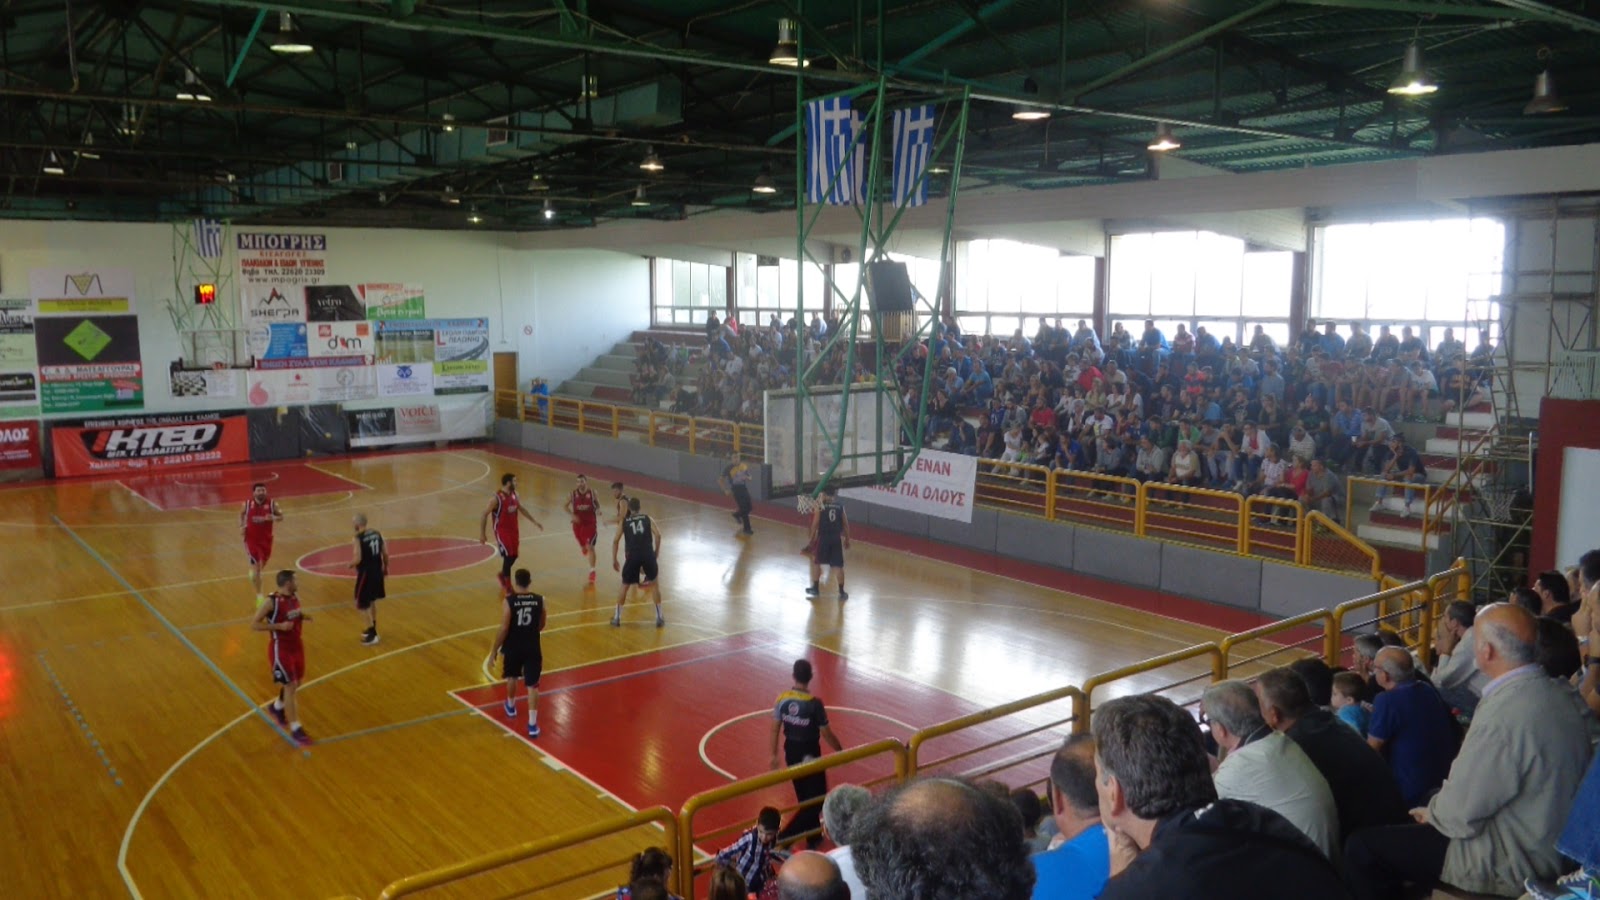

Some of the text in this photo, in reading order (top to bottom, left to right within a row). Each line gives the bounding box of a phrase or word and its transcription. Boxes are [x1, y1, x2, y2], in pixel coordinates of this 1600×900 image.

[240, 233, 323, 250] ΜΠΟΓΡΗΣ
[916, 456, 951, 477] ΕΝΑΝ
[900, 482, 919, 499] ΓΙΑ
[922, 486, 966, 507] ΟΛΟΥΣ
[828, 508, 837, 522] 6
[630, 520, 645, 535] 14
[369, 539, 379, 555] 11
[517, 607, 532, 626] 15
